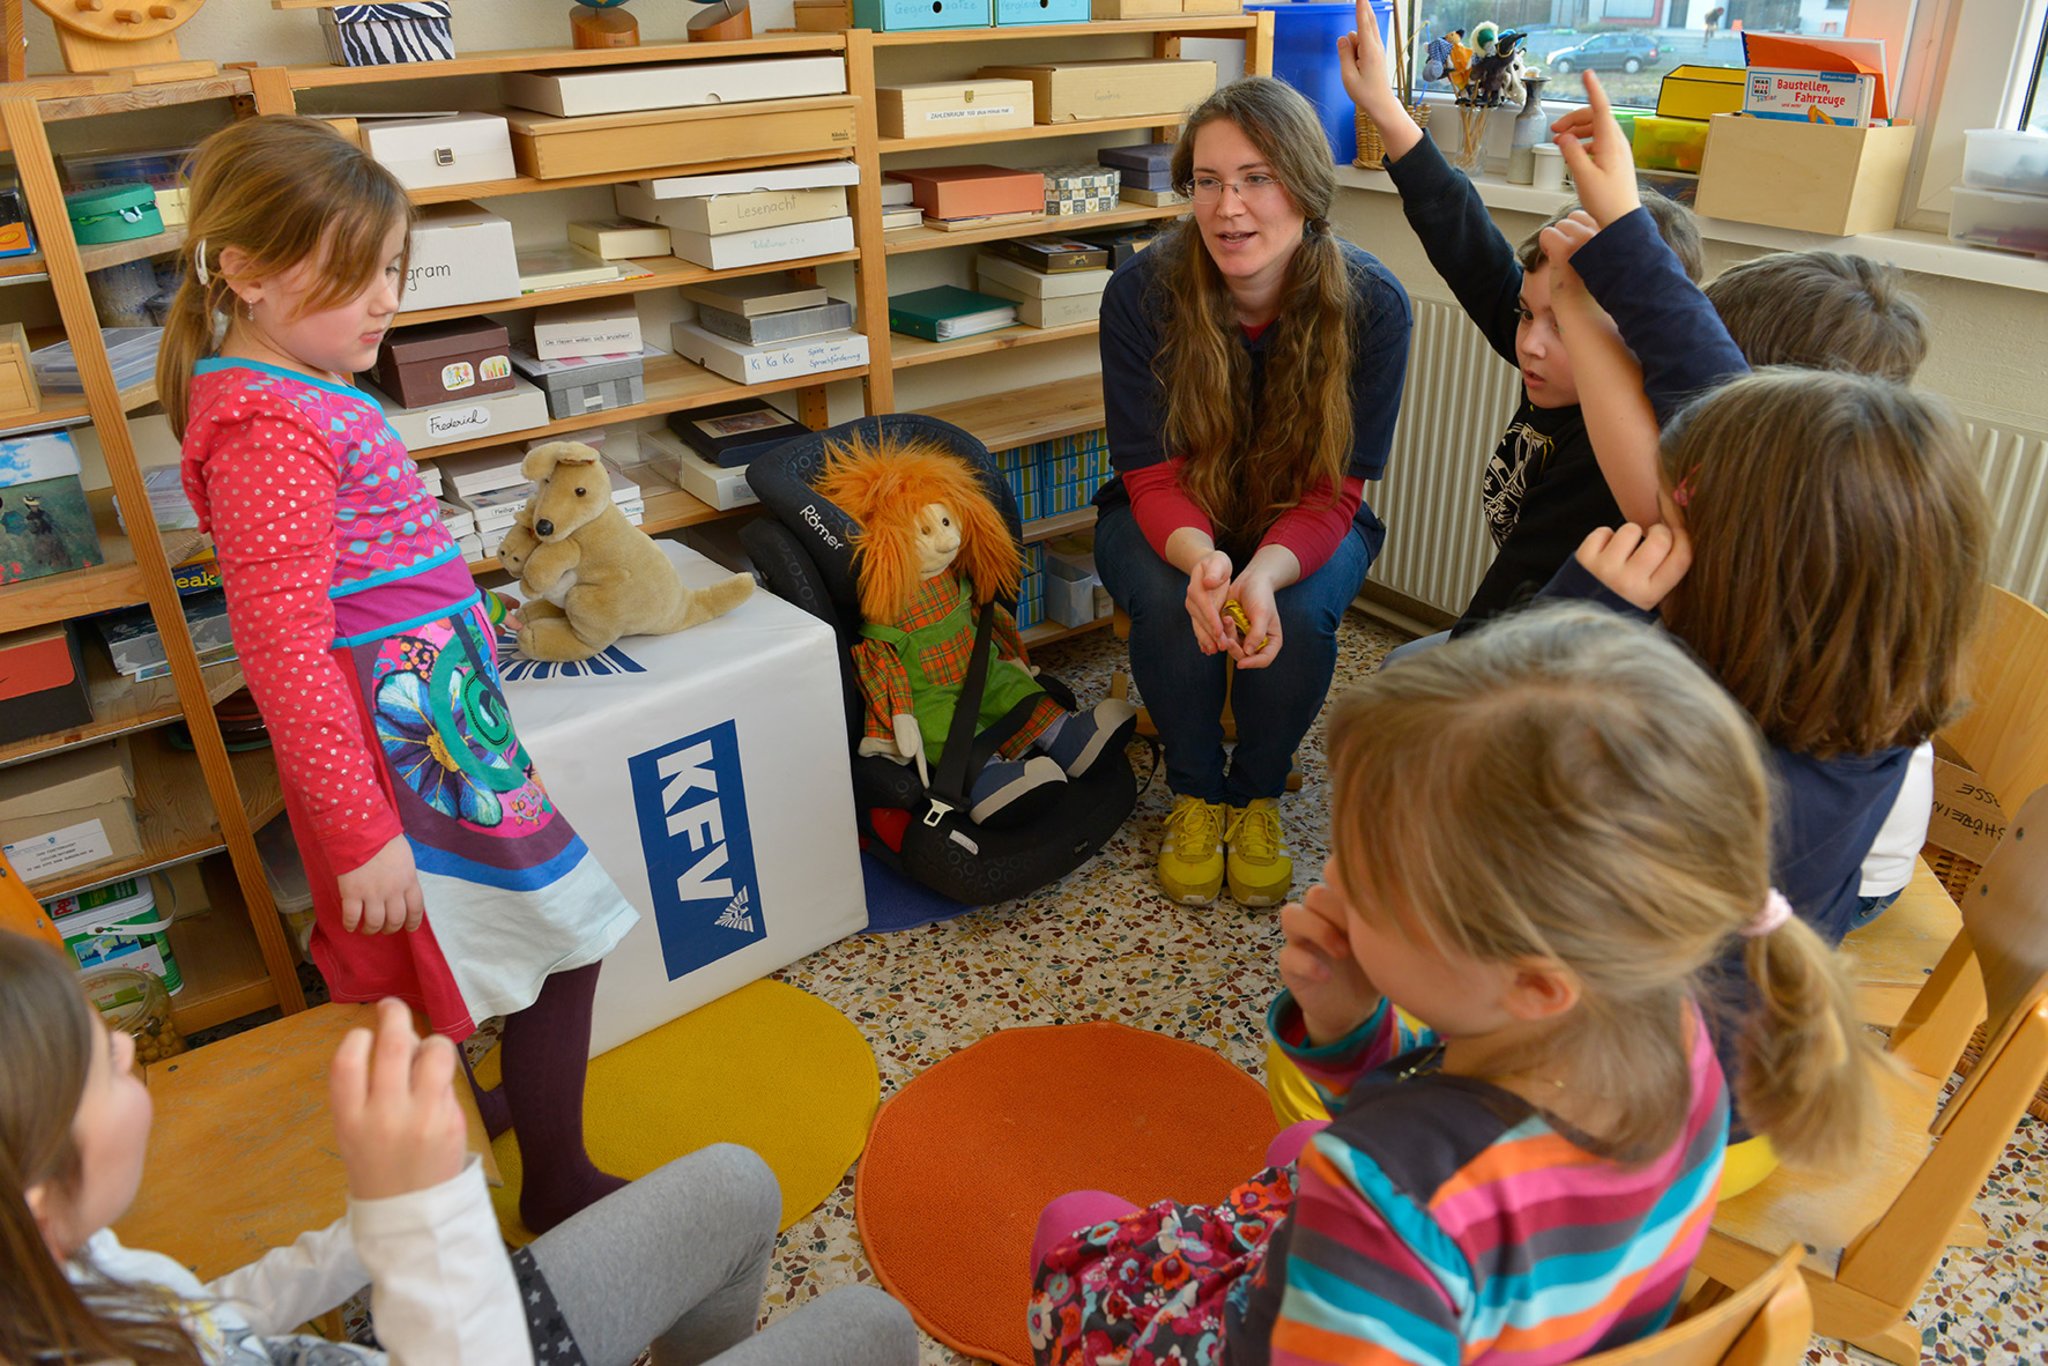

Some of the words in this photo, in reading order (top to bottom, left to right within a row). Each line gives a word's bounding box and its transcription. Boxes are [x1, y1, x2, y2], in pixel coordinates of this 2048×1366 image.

[1777, 79, 1831, 94] Baustellen,
[1795, 92, 1846, 108] Fahrzeuge
[737, 194, 797, 219] Lesenacht
[799, 504, 844, 550] Römer
[656, 739, 735, 902] KFV
